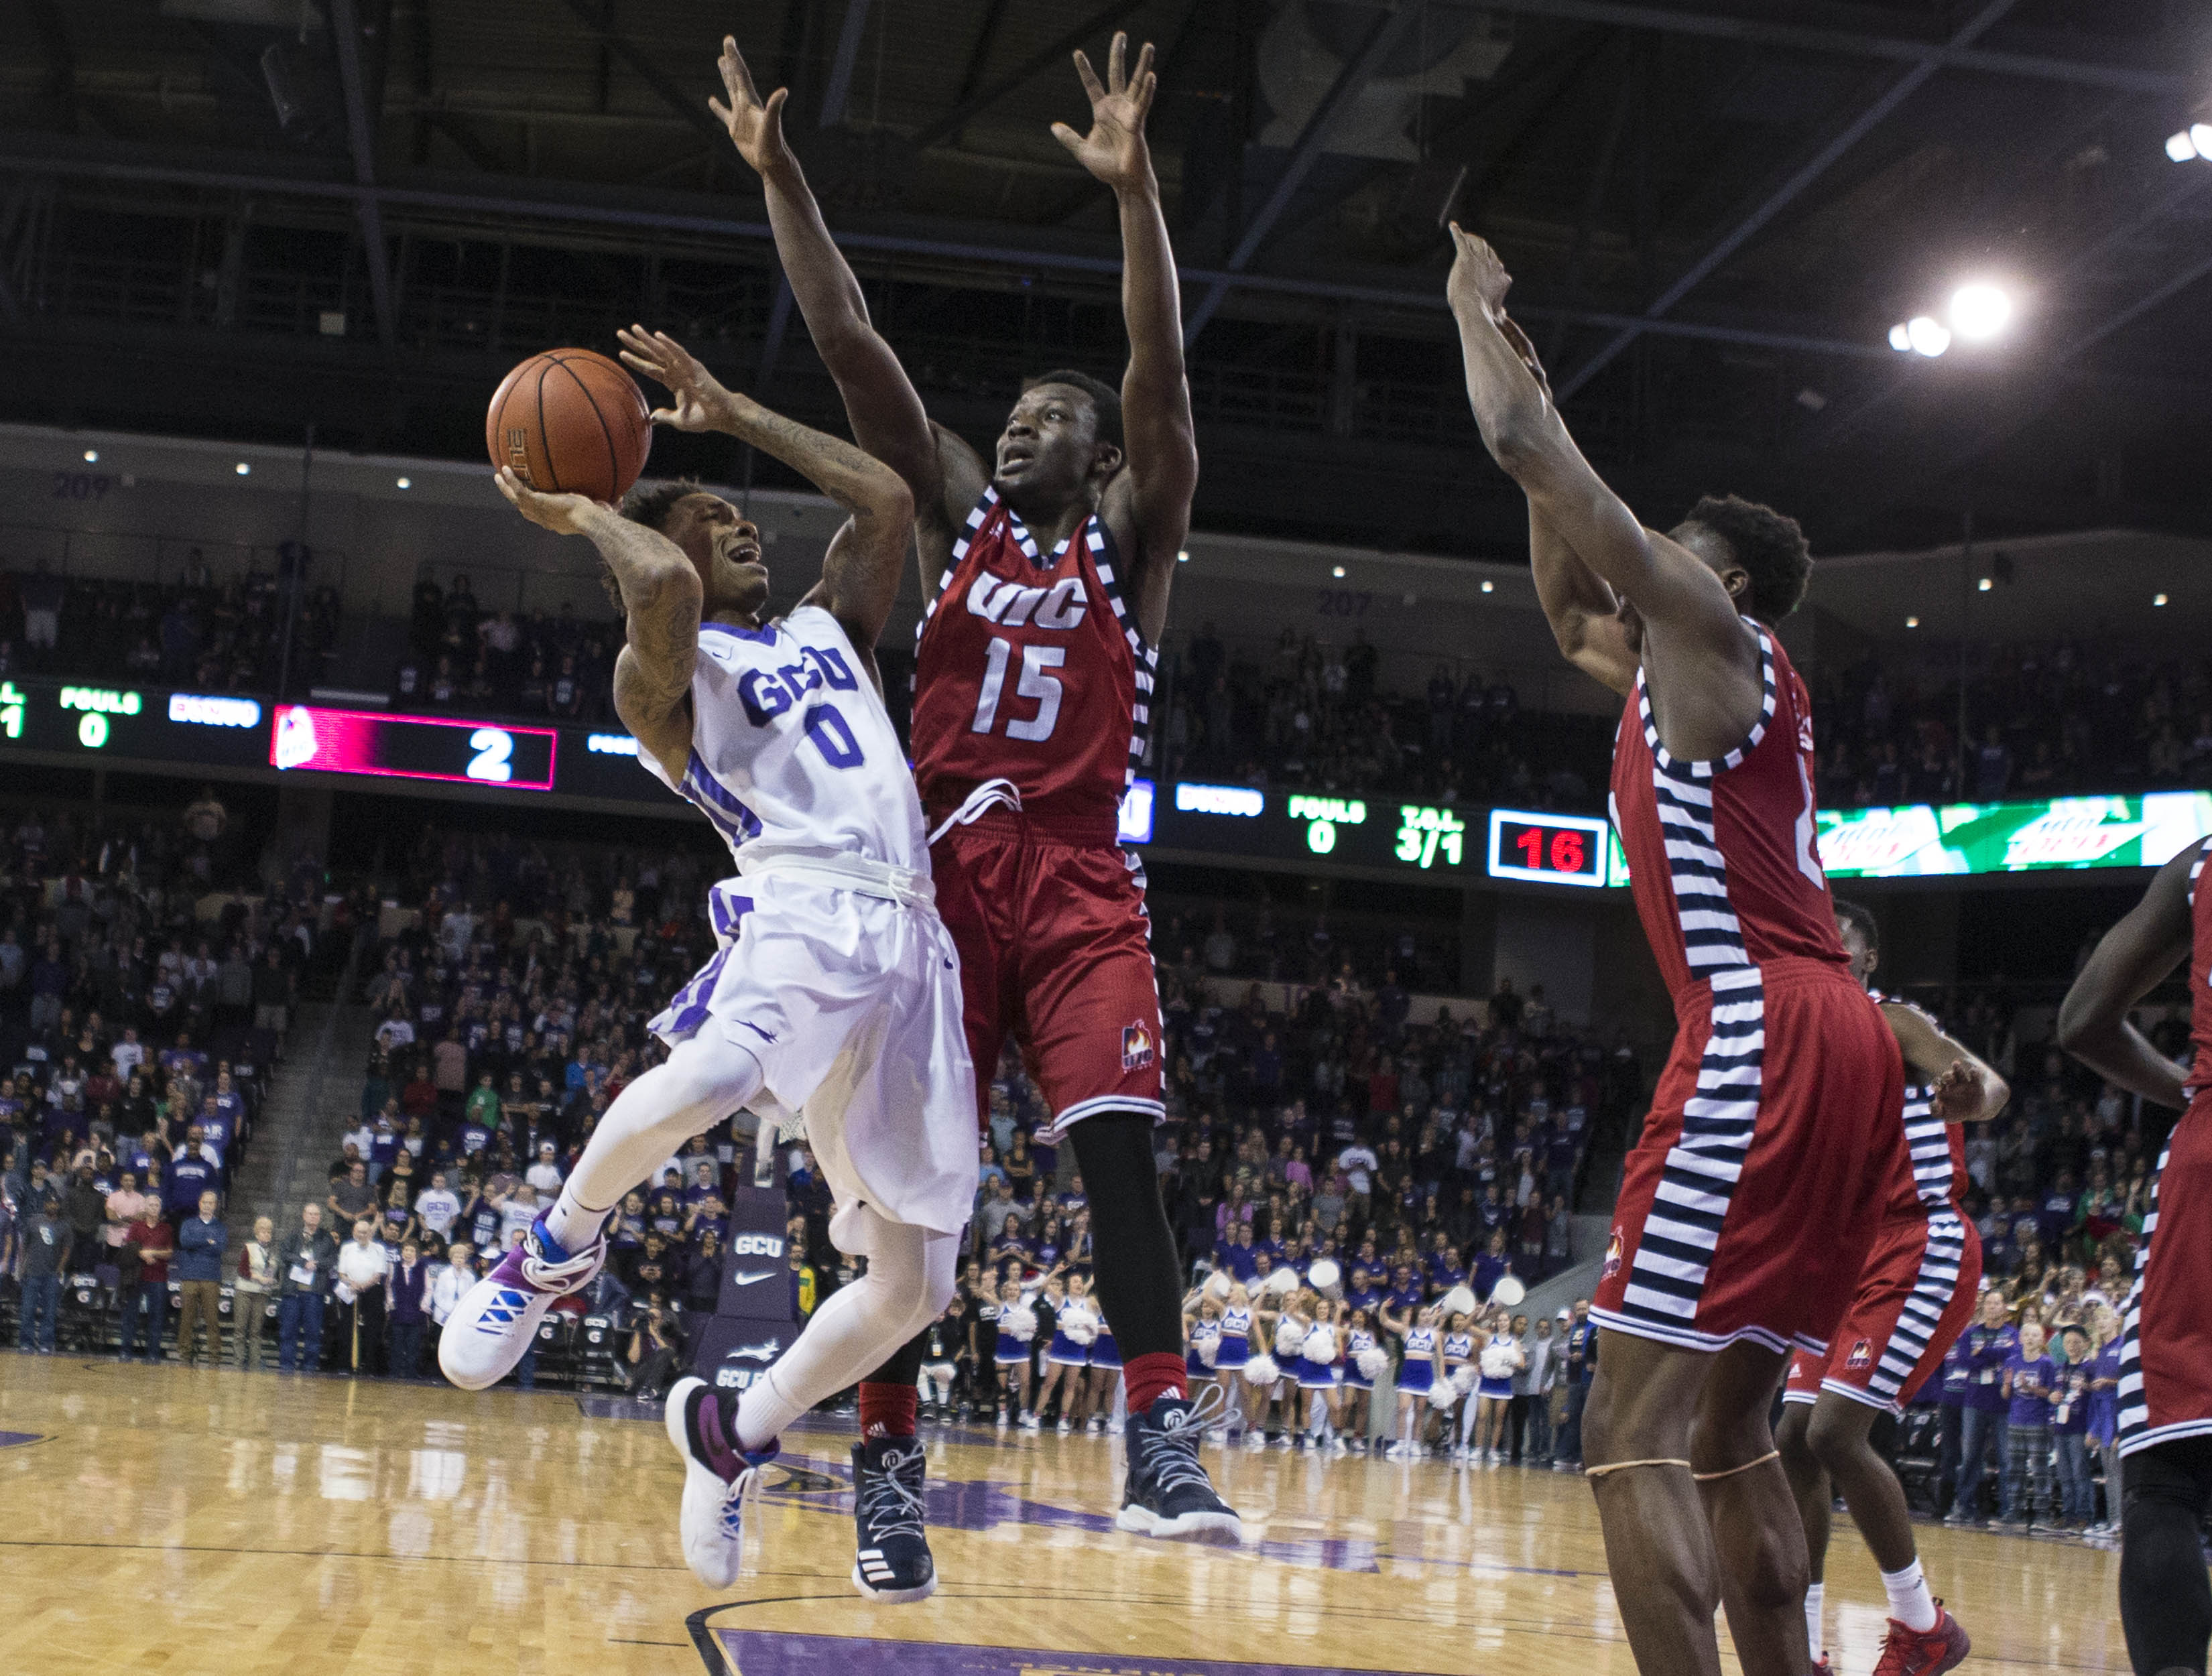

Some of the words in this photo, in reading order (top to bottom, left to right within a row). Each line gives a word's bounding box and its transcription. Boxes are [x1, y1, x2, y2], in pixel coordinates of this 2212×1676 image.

[967, 571, 1089, 630] UIC
[60, 686, 142, 716] FOULS
[738, 645, 859, 728] GCU
[971, 637, 1066, 742] 15
[78, 710, 109, 749] 0
[806, 702, 865, 769] 0
[467, 728, 514, 783] 2
[1288, 794, 1367, 825] FOULS
[1308, 819, 1336, 854] 0
[1394, 826, 1463, 868] 3/1
[1517, 828, 1584, 873] 16
[735, 1235, 784, 1258] GCU
[1224, 1317, 1248, 1330] GCU
[715, 1368, 751, 1389] GCU
